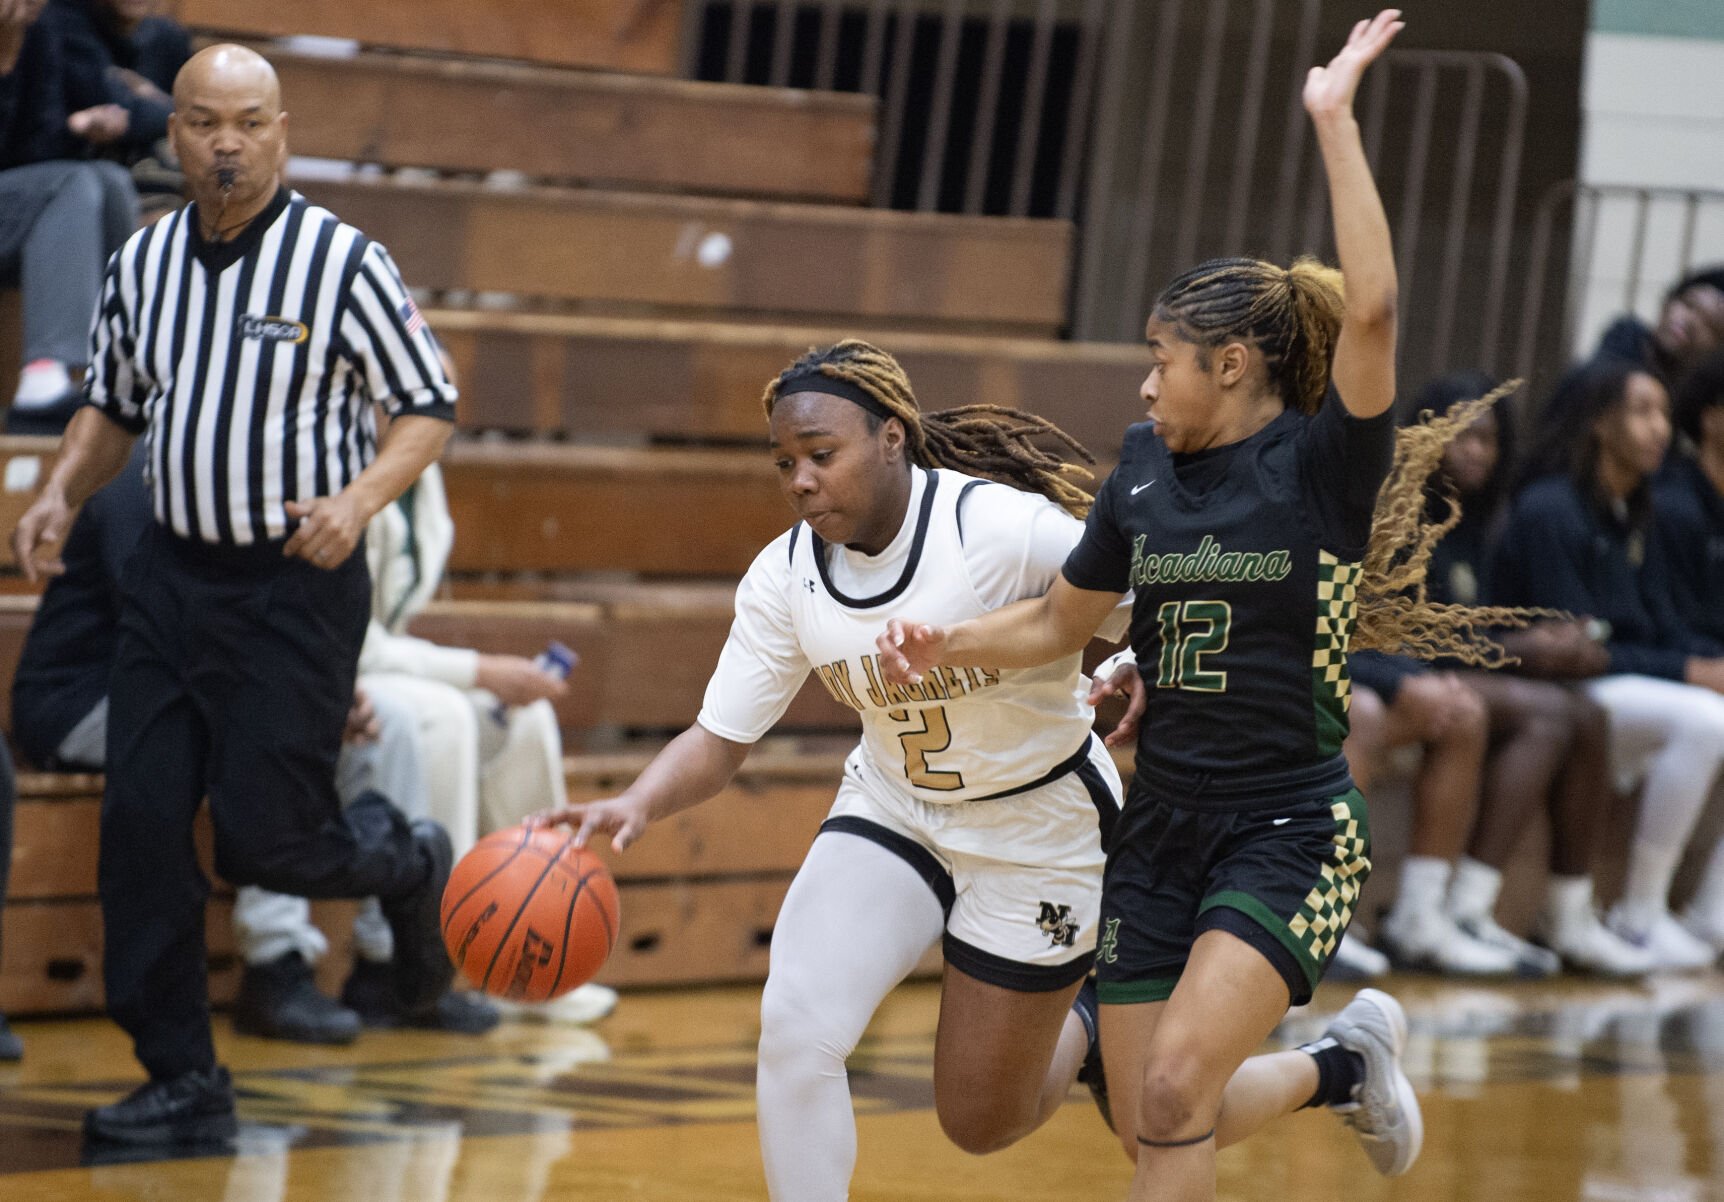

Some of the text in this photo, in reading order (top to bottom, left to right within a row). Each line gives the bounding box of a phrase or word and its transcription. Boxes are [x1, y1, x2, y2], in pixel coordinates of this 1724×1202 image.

[1128, 533, 1293, 587] Acadiana
[1156, 600, 1232, 692] 12
[814, 658, 866, 711] DY
[888, 704, 965, 792] 2
